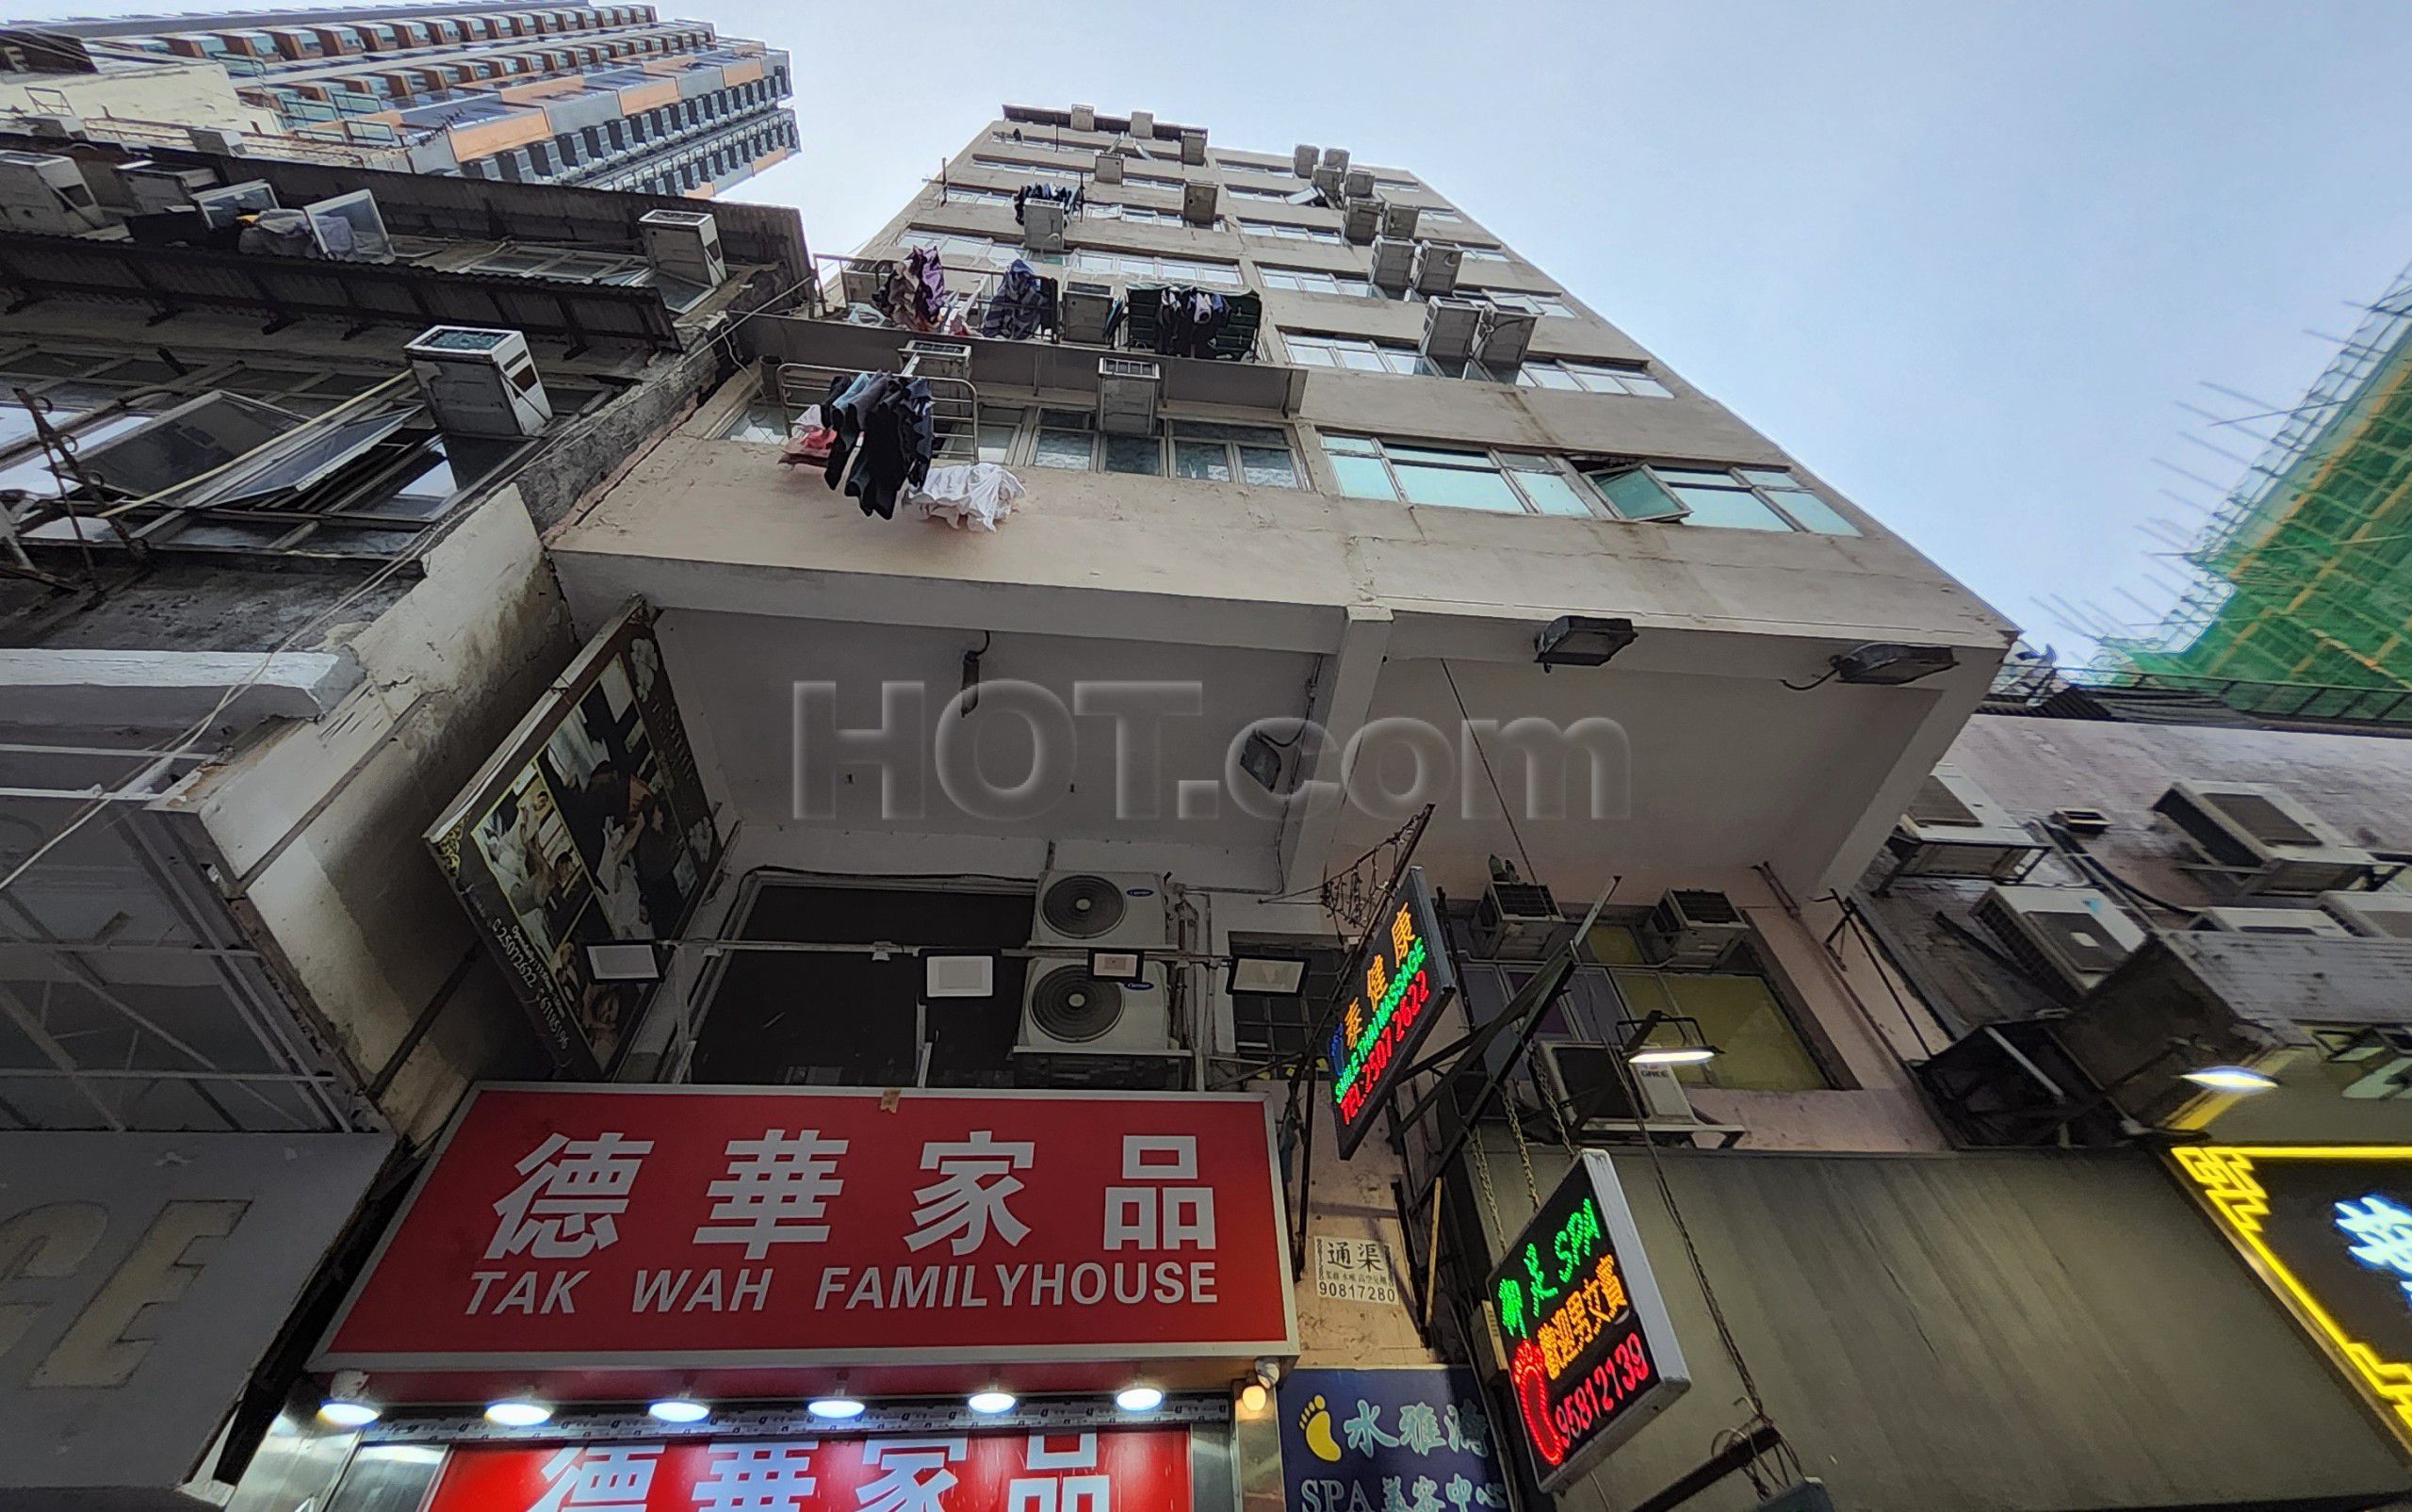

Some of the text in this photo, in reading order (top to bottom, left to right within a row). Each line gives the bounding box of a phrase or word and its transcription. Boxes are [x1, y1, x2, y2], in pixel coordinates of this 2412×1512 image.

[1345, 902, 1416, 1050] 泰健康
[1392, 969, 1429, 1042] 2622
[1334, 936, 1426, 1105] SMILE THAI MASSAGE
[483, 1130, 1217, 1260] 德華家品
[465, 1260, 1218, 1315] TAK WAH FAMILYHOUSE
[1319, 1281, 1395, 1303] 90817280
[1328, 1241, 1385, 1273] 通渠
